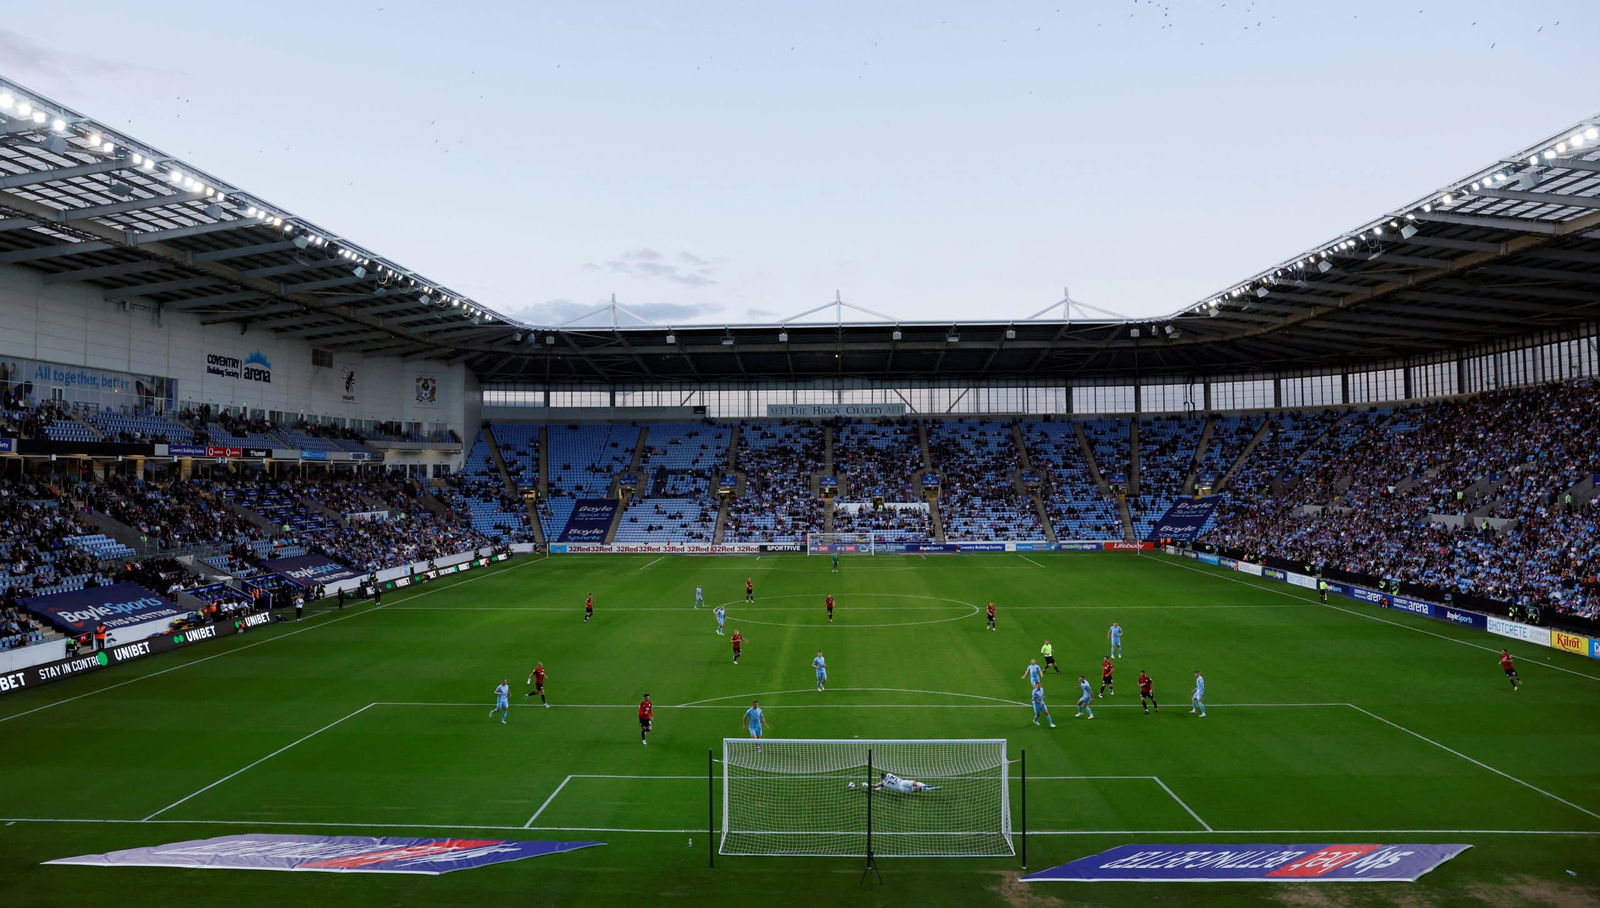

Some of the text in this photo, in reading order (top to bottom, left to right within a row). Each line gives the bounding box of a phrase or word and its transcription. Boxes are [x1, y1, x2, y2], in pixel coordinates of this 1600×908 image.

[206, 353, 240, 369] COVENTRY
[34, 364, 51, 380] All
[53, 368, 99, 387] together,
[243, 366, 272, 383] arena
[813, 406, 840, 415] HIGGS
[845, 405, 884, 415] CHARITY
[1177, 502, 1213, 510] Boyle
[568, 528, 604, 536] Boyle
[1160, 525, 1197, 533] Boyle
[56, 597, 163, 623] BoyleSports
[1408, 600, 1429, 614] arena
[244, 611, 271, 628] UNIBET
[1446, 611, 1473, 624] BoyleSports
[186, 625, 216, 643] UNIBET
[1488, 619, 1528, 638] SHOTCRETE
[113, 641, 151, 662] UNIBET
[38, 664, 61, 680] STAY
[62, 663, 72, 674] IN
[1098, 846, 1415, 875] sky bet BETTING BETTER
